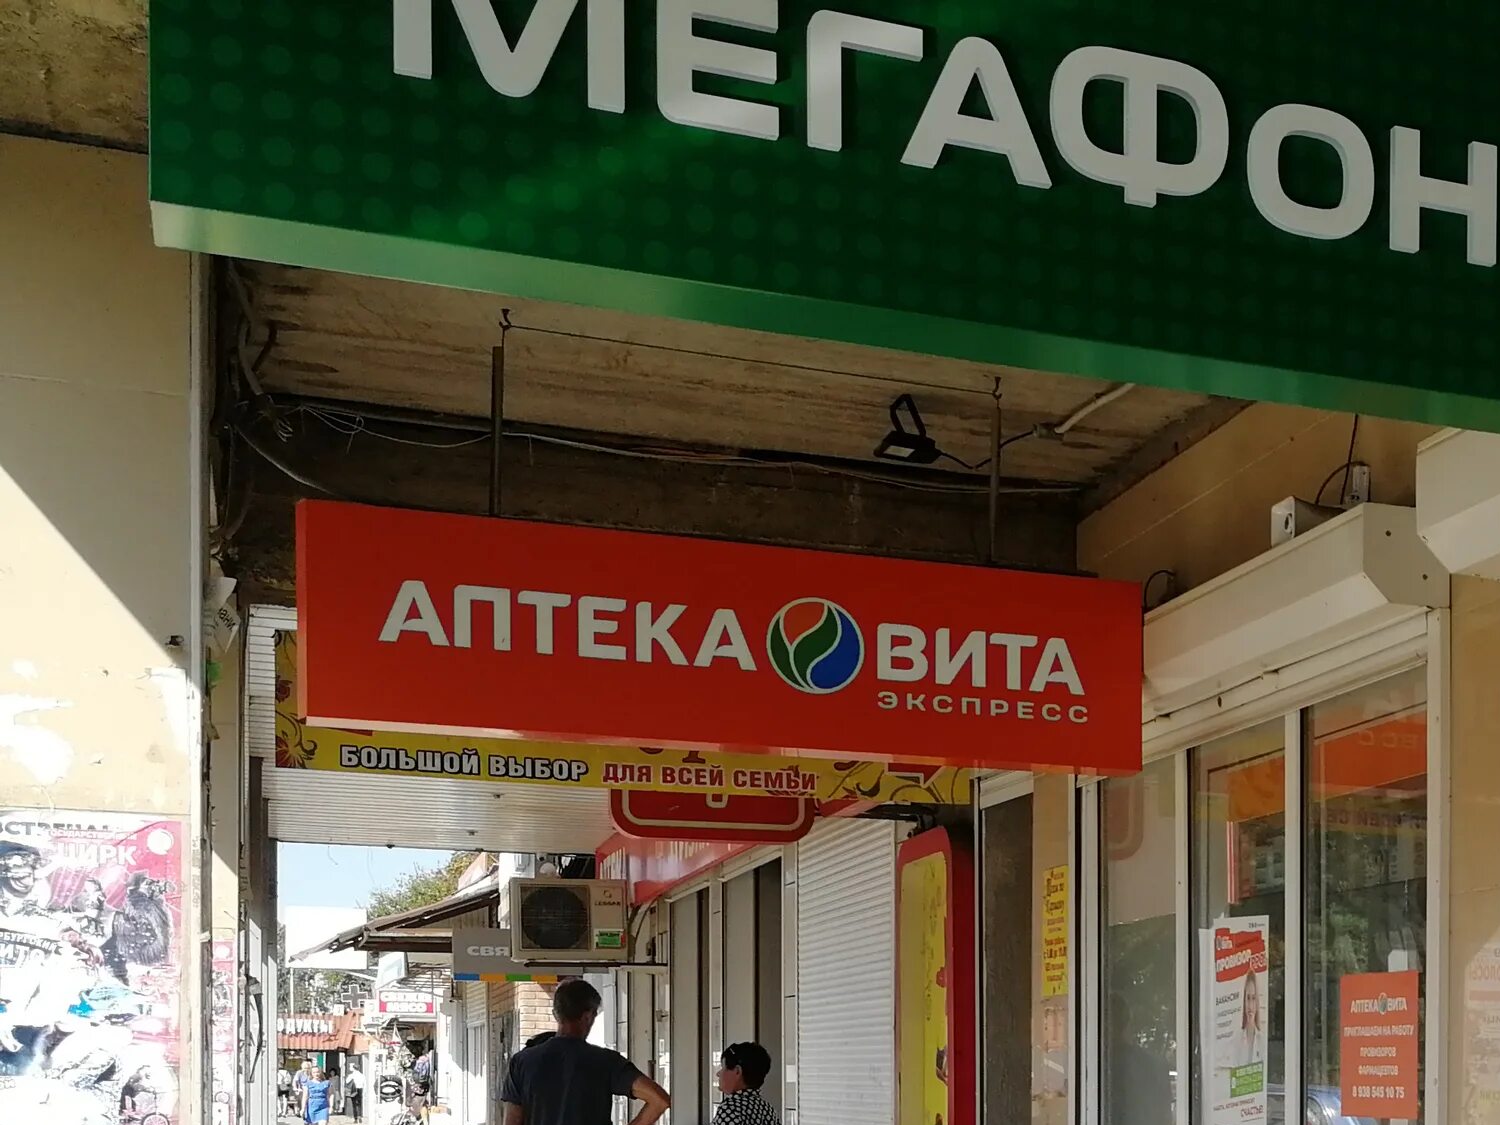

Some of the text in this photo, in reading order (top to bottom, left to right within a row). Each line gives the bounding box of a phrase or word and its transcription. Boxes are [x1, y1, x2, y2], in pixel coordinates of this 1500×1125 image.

[379, 579, 1086, 695] АПТЕКА ВИТА
[878, 690, 1089, 723] ЭКСПРЕСС
[340, 745, 589, 783] БОЛЬШОЙ ВЫБОР
[602, 762, 816, 791] ДЛЯ ВСЕЙ СЕМЬИ
[466, 945, 511, 957] СВЯ
[1351, 998, 1407, 1013] АПТЕКА ВИТА
[277, 1018, 333, 1034] ОДУКТЫ
